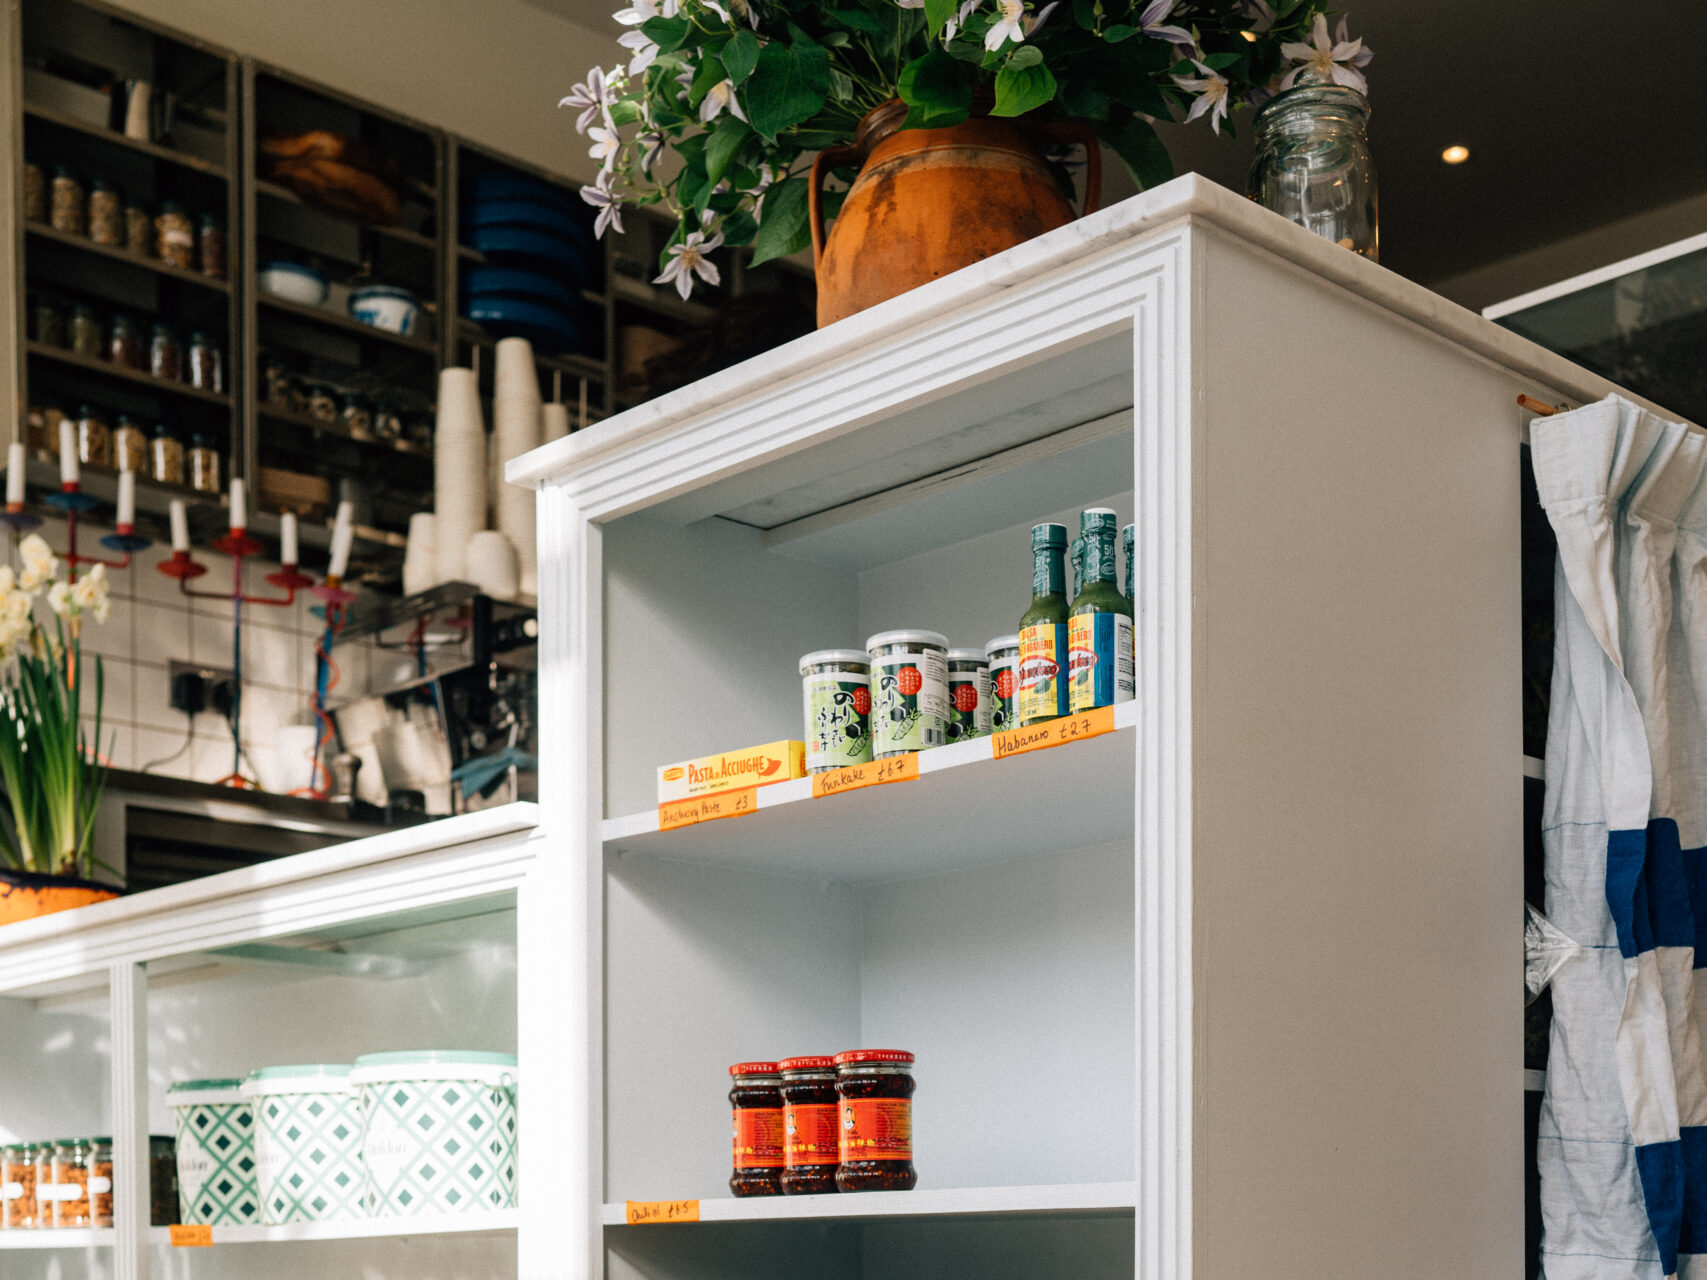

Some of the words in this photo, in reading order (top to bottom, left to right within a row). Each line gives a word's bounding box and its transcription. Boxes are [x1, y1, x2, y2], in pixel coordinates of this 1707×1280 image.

[997, 730, 1049, 756] Habanero
[688, 763, 714, 785] PASTA
[720, 755, 765, 778] ACCIUGHE
